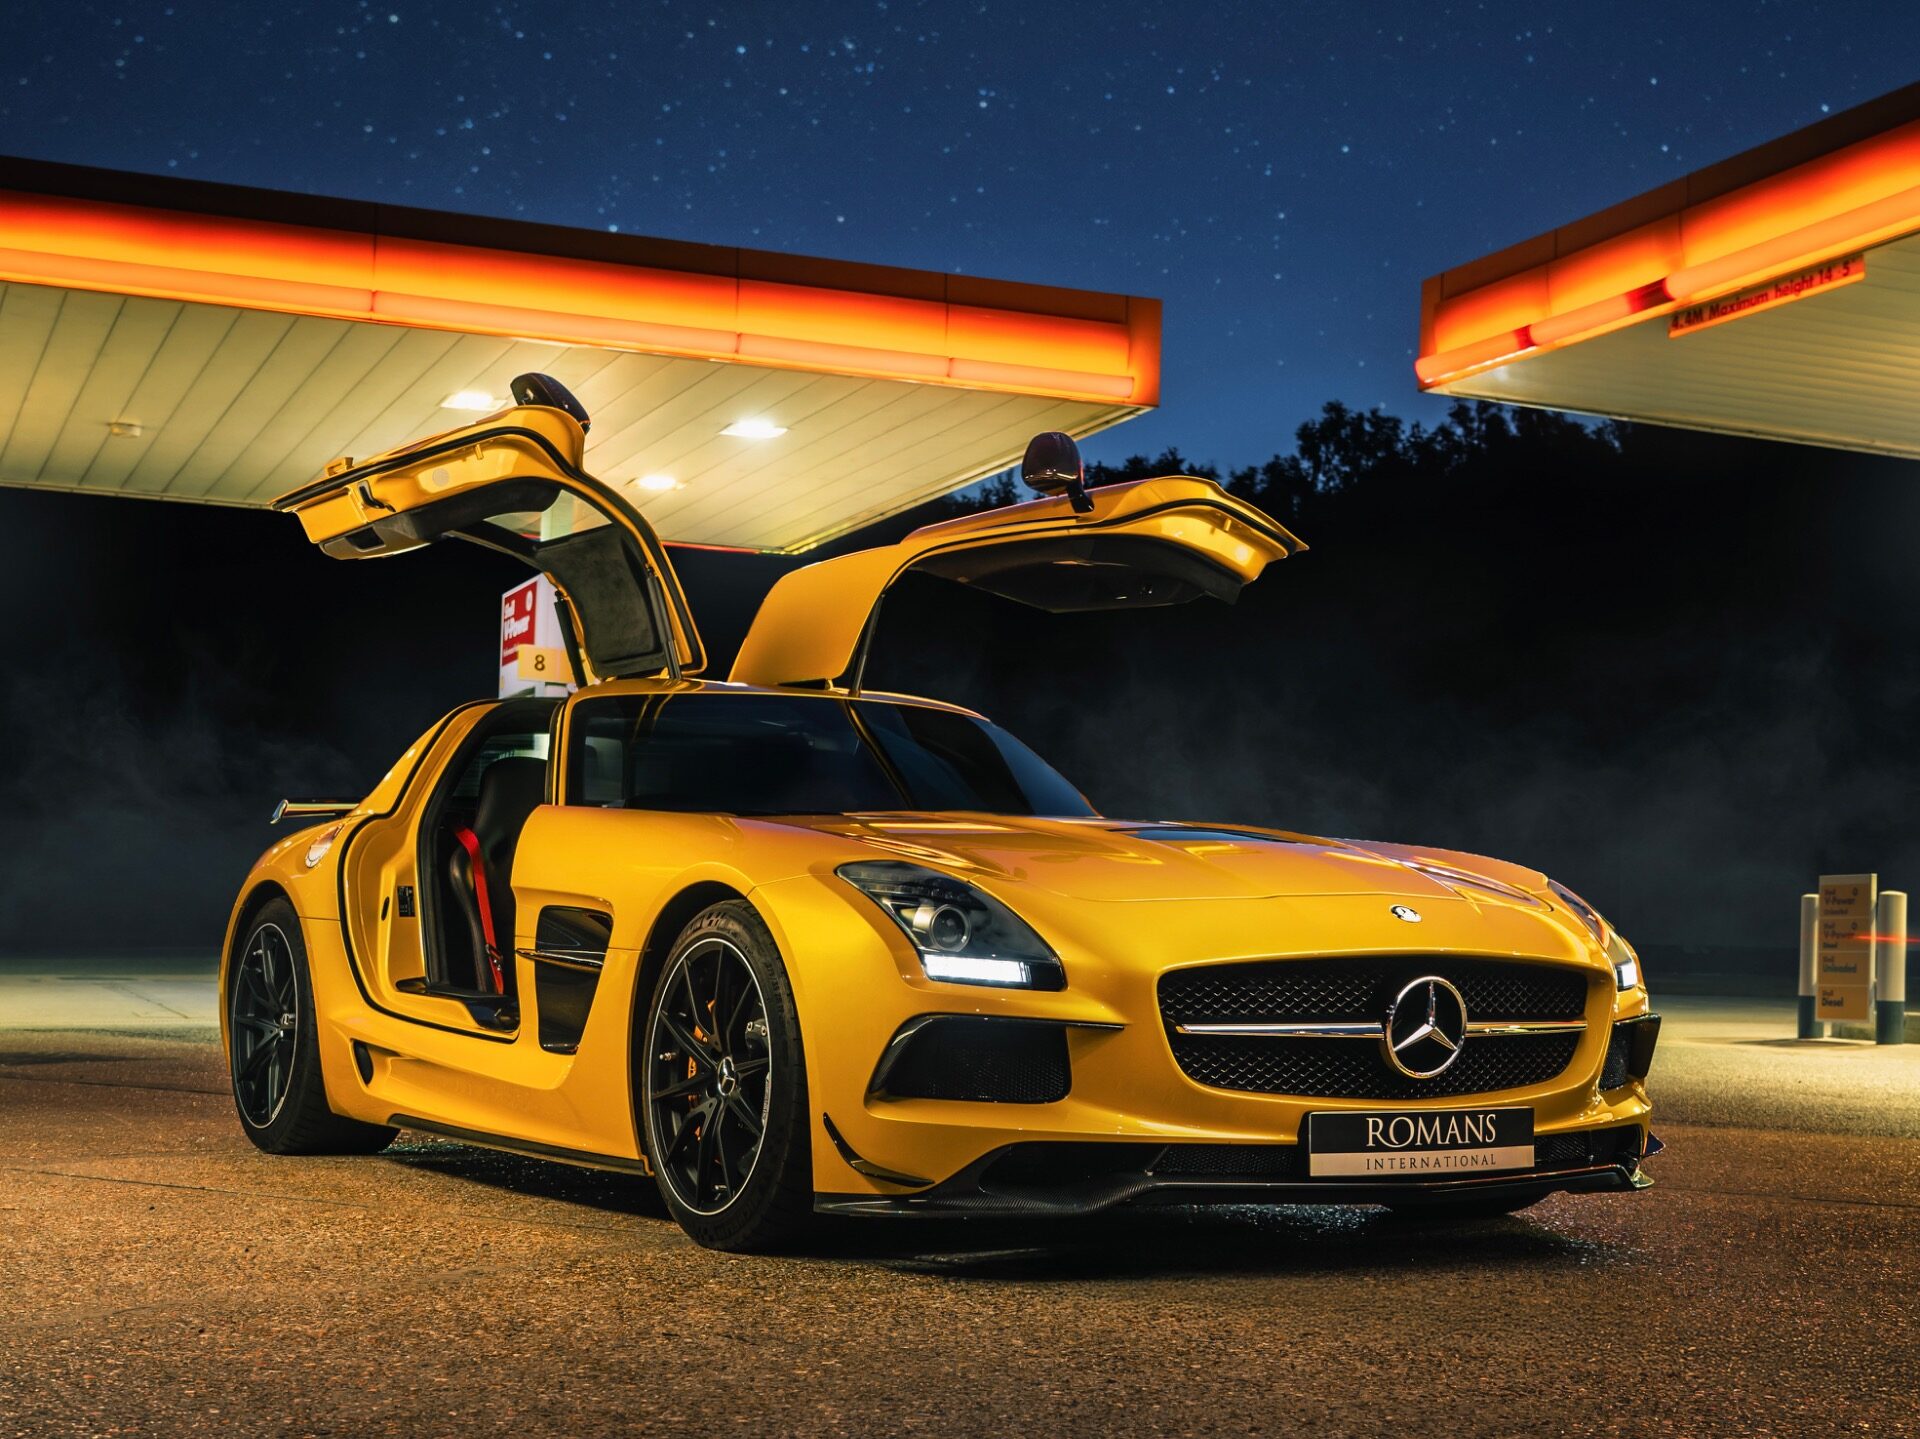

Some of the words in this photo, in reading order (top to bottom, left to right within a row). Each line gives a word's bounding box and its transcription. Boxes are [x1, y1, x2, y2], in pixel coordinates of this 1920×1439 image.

[1709, 292, 1769, 320] Maximum
[1774, 274, 1814, 297] height
[534, 654, 546, 671] 8
[1365, 1113, 1497, 1149] ROMANS
[1366, 1153, 1497, 1171] INTERNATIONAL
